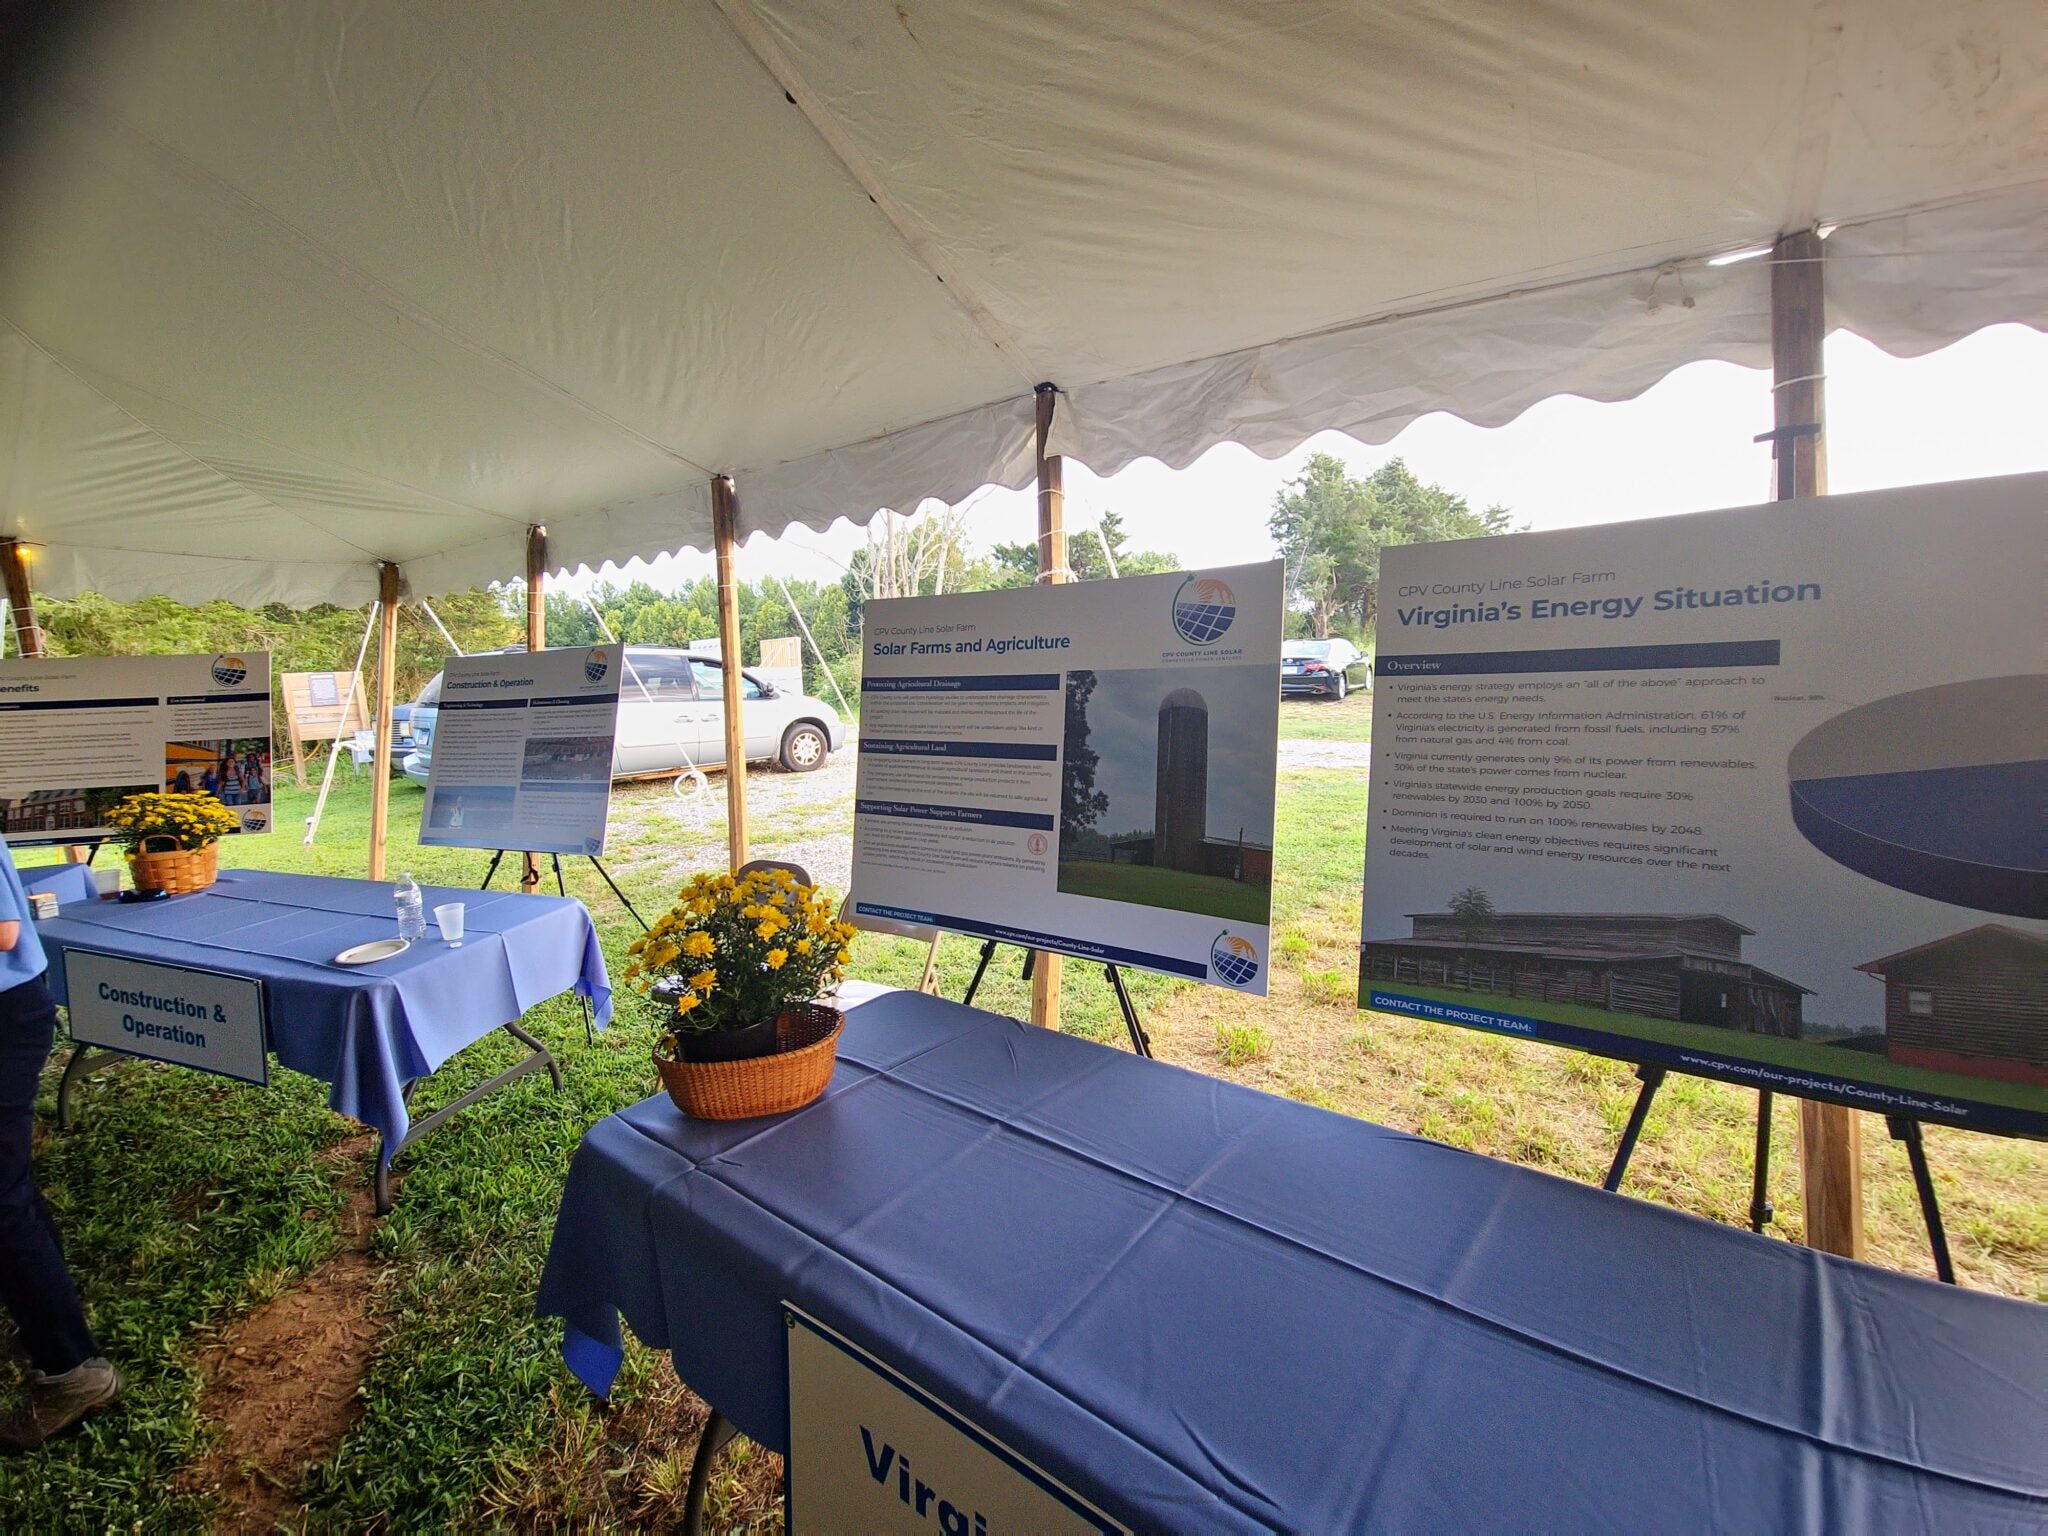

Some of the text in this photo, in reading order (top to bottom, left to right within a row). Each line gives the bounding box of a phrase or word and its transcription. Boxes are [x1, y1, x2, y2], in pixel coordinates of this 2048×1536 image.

[1398, 570, 1616, 597] CPV County Line Solar Farm
[1397, 580, 1821, 629] Virginia's Energy Situation
[874, 627, 889, 636] CPV
[891, 627, 917, 635] County
[936, 625, 954, 633] Solar
[957, 623, 976, 632] Farm
[874, 635, 1070, 656] Solar Farms and Agriculture
[1387, 660, 1441, 670] Overview
[0, 684, 39, 692] enefits
[447, 680, 491, 689] Construction
[500, 677, 533, 687] Operation
[1398, 683, 1437, 692] Virginia's
[1440, 684, 1472, 692] energy
[1475, 683, 1514, 692] strategy
[1518, 681, 1562, 690] employs
[1567, 681, 1580, 689] an
[1603, 680, 1615, 688] of
[1685, 677, 1746, 688] approach
[1752, 677, 1765, 685] to
[1475, 696, 1509, 704] energy
[1396, 712, 1443, 720] According
[1500, 712, 1535, 721] Energy
[1539, 711, 1602, 720] Information
[1701, 710, 1728, 720] 61%
[1732, 710, 1746, 719] of
[1396, 724, 1435, 732] Virginia's
[1438, 724, 1485, 733] electricity
[1498, 725, 1550, 734] generated
[1554, 725, 1580, 733] from
[1584, 724, 1612, 733] fossil
[1649, 725, 1707, 735] including
[1711, 724, 1740, 734] 57%
[1420, 736, 1452, 744] natural
[1517, 737, 1543, 745] from
[1546, 738, 1570, 746] coal.
[1395, 752, 1757, 769] Virginia currently generates only 9% of its power from renewables.
[1417, 763, 1426, 771] of
[1447, 765, 1477, 774] state's
[1480, 767, 1511, 777] power
[1515, 769, 1550, 777] comes
[1553, 769, 1580, 778] from
[1584, 770, 1628, 779] nuclear.
[1393, 779, 1694, 801] Virginia's statewide energy production goals require 30%
[1392, 792, 1592, 810] renewables by 2030 and 100% by 2050.
[1392, 808, 1437, 819] Dominion
[1441, 810, 1448, 819] is
[1450, 811, 1492, 822] required
[1495, 815, 1505, 823] to
[1509, 816, 1526, 824] run
[1548, 818, 1578, 828] 100%
[1581, 821, 1648, 832] renewables
[1652, 823, 1666, 834] by
[1391, 825, 1718, 857] Meeting Virginia's clean energy objectives requires significant
[1389, 849, 1430, 859] decades.
[1390, 836, 1732, 872] development of solar and wind energy resources over the next
[858, 906, 881, 915] CONTACT
[894, 912, 916, 920] PROJECT
[99, 982, 226, 1024] Construction &
[1375, 996, 1532, 1033] CONTACT THE PROJECT TEAM:
[122, 1014, 206, 1048] Operation
[1680, 1053, 1969, 1117] www.cpv.com/our-projects/County-Line-Solar
